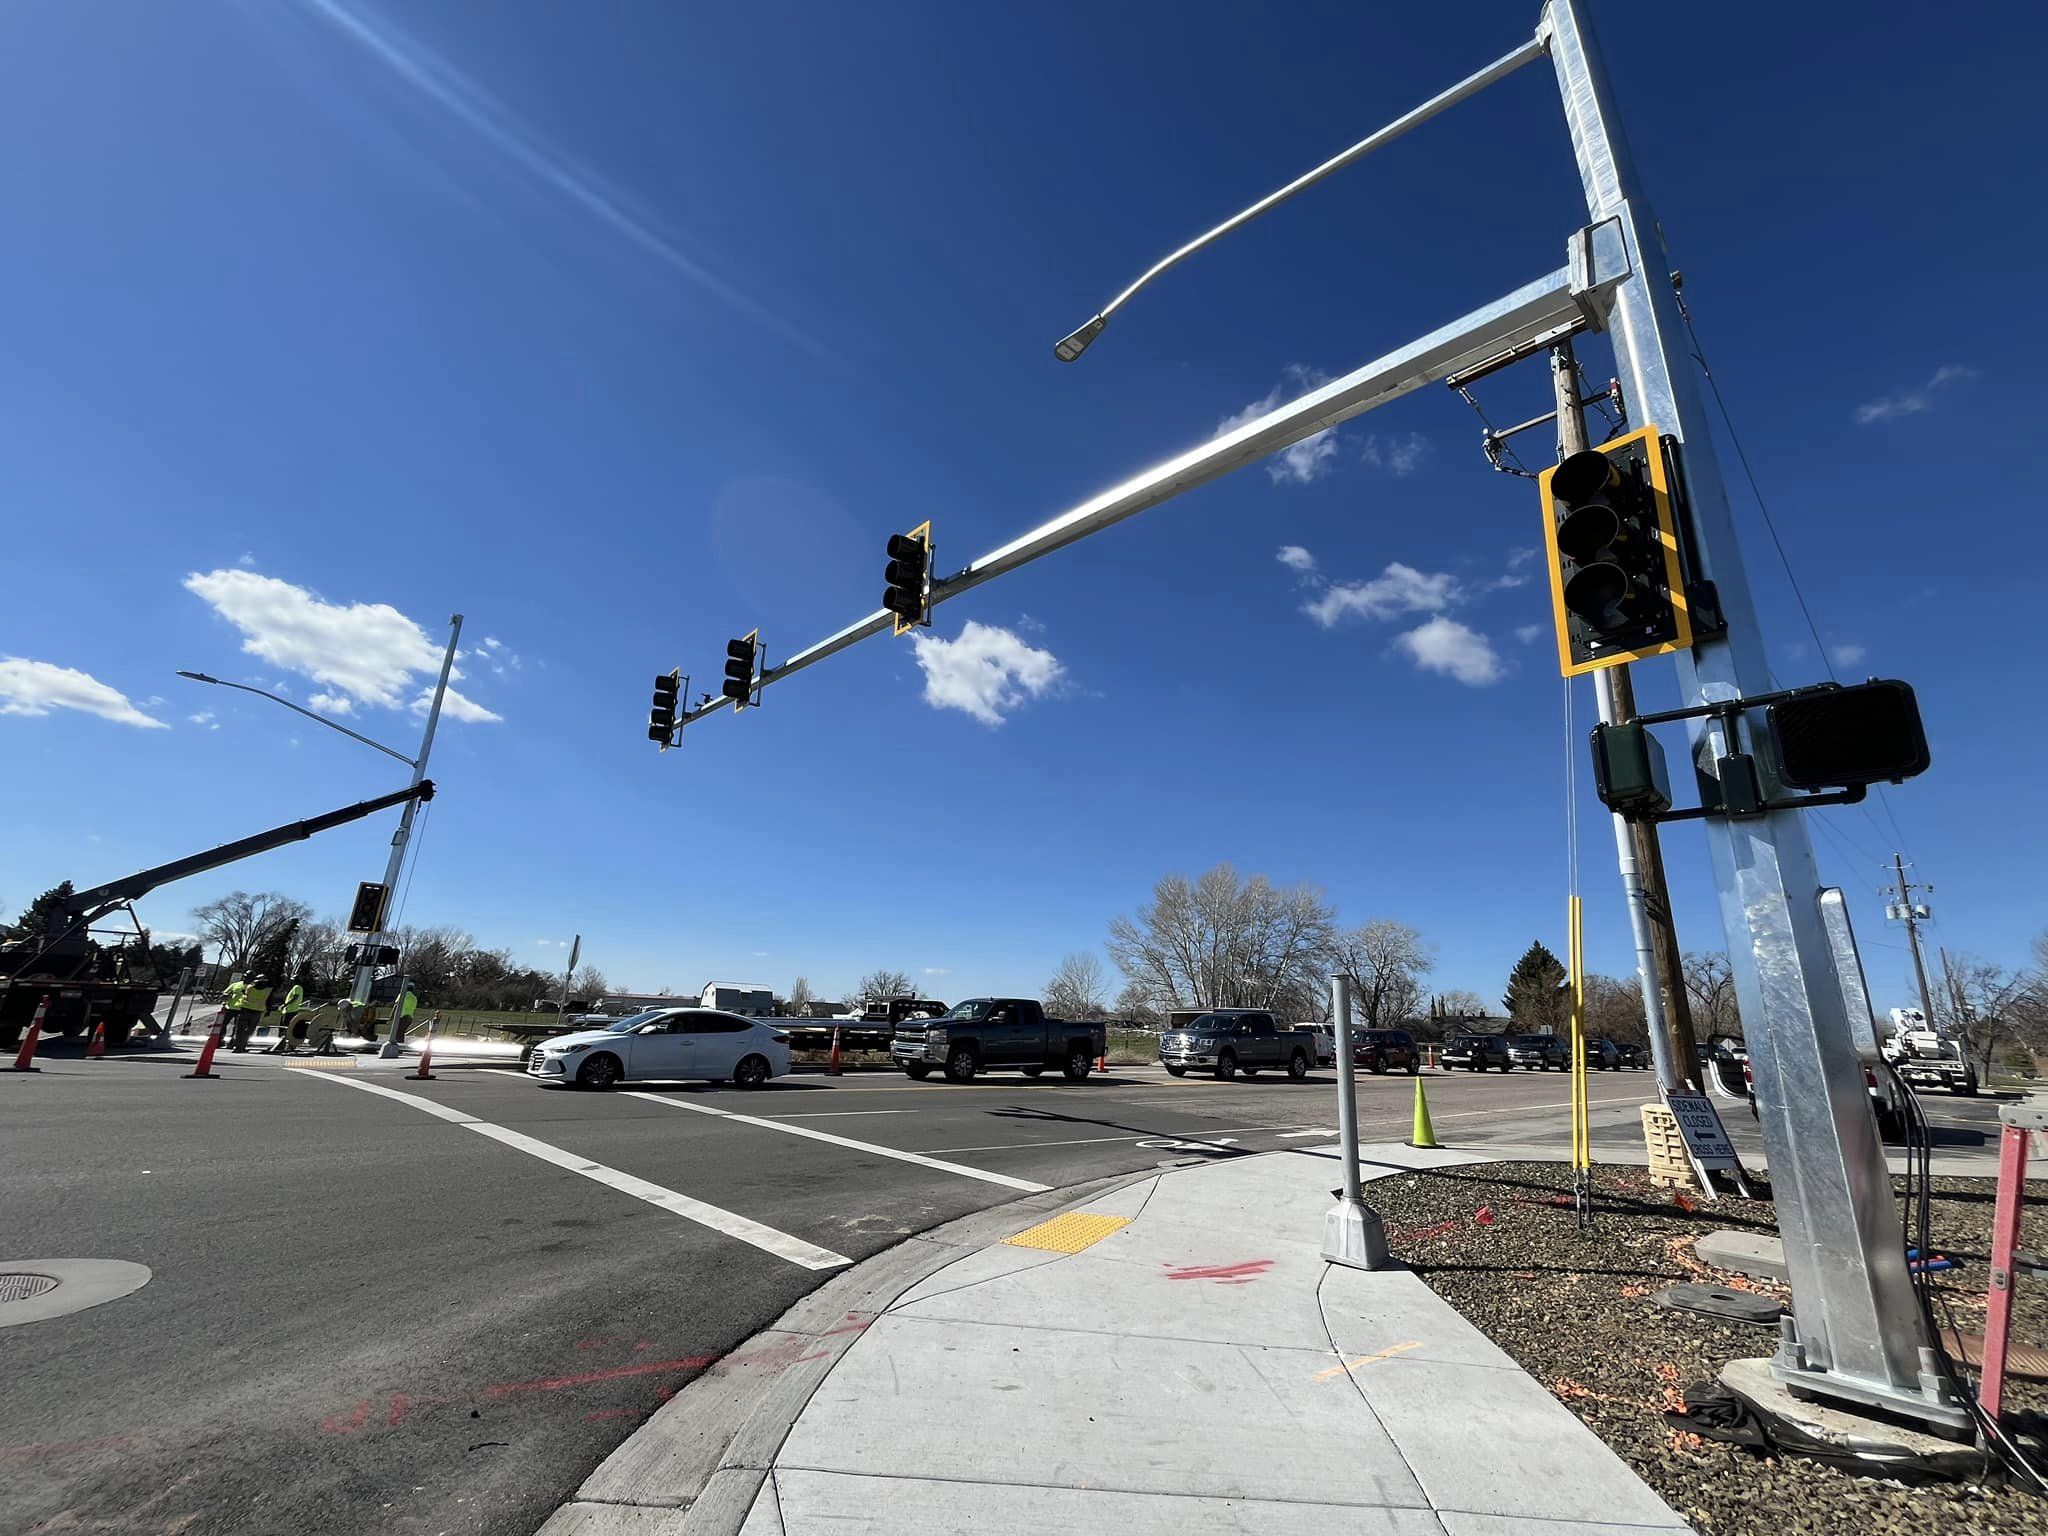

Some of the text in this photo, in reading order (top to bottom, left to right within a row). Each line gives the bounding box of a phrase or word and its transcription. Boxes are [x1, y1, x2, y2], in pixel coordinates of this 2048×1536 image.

[1671, 1099, 1711, 1113] SIDEWALK
[1682, 1115, 1713, 1128] CLOSED
[1691, 1143, 1733, 1155] CROSS HERE
